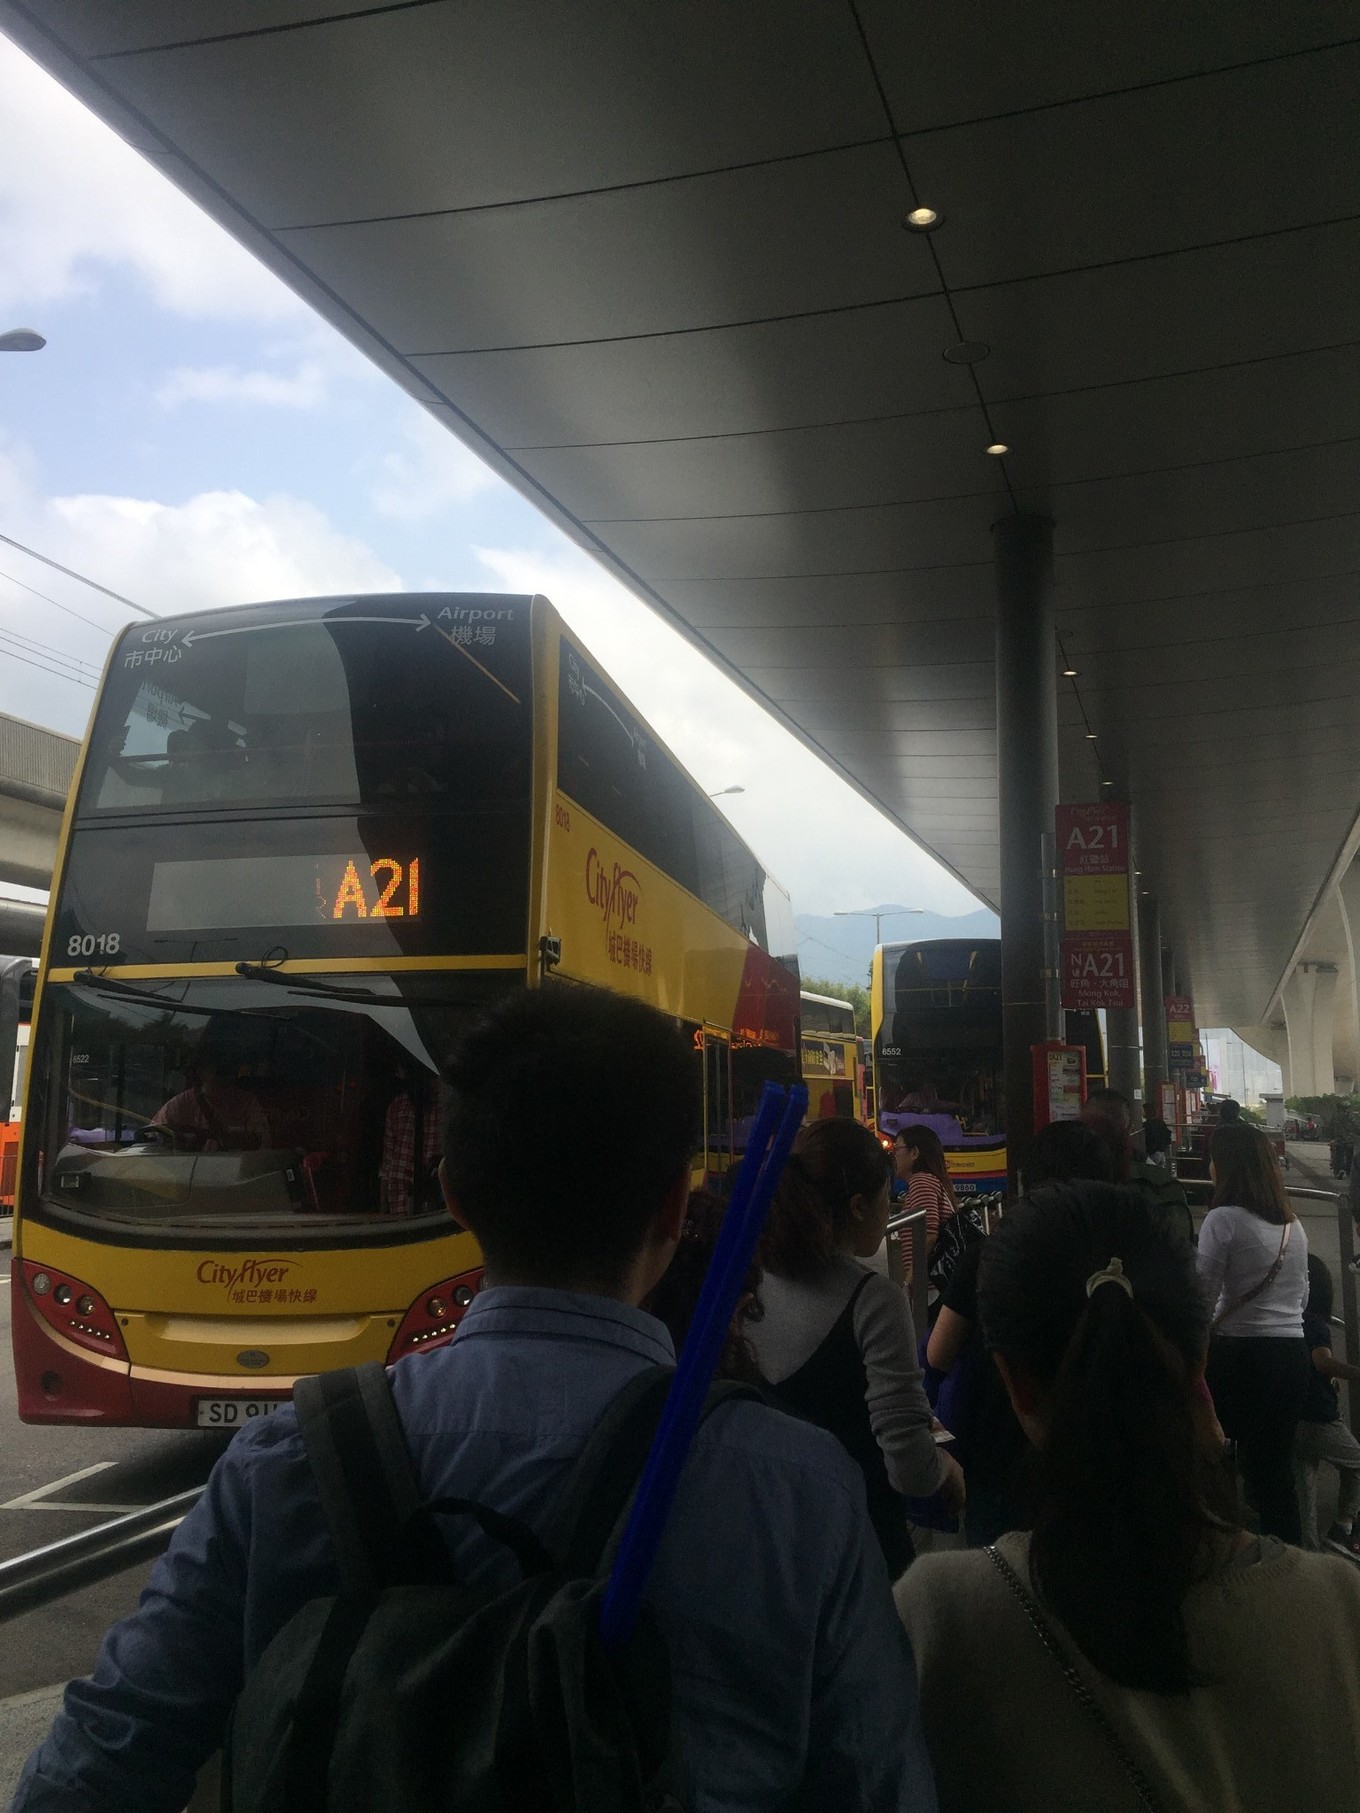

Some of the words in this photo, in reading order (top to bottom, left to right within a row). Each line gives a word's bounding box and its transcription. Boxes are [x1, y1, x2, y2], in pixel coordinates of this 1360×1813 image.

[437, 605, 515, 622] Airport
[142, 628, 178, 645] City
[451, 625, 497, 647] 機場
[124, 645, 183, 670] 市中心
[555, 804, 570, 832] 8018
[1066, 825, 1118, 850] A21
[1102, 864, 1127, 872] Station
[333, 857, 419, 919] A21
[67, 932, 121, 957] 8018
[1079, 990, 1102, 998] Mong
[1169, 1004, 1190, 1013] A22
[209, 1403, 238, 1424] SD
